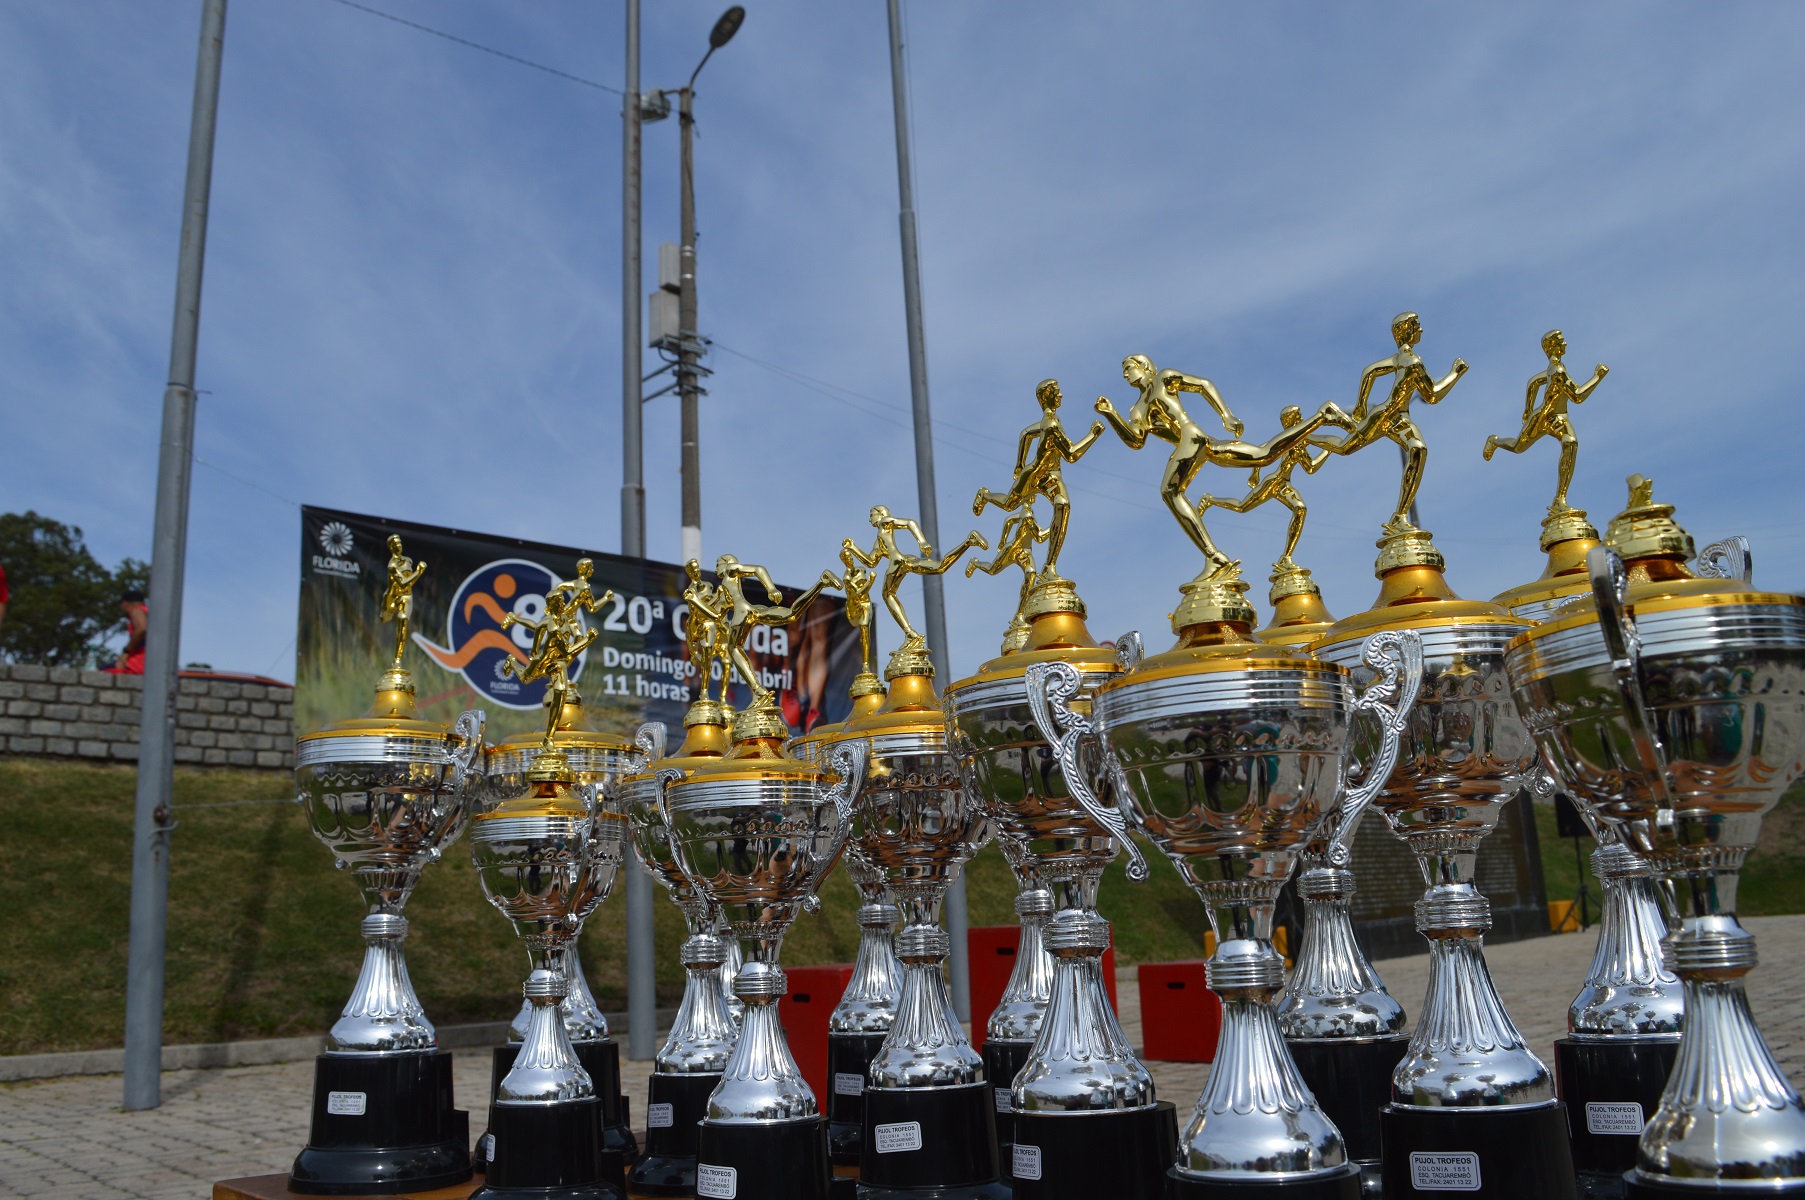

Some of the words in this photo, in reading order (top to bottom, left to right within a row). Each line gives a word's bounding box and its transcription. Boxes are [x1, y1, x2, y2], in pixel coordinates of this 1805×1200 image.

[313, 555, 361, 575] FLORIDA
[603, 646, 696, 681] Domingo
[603, 674, 630, 696] 11
[636, 675, 690, 703] horas
[709, 1169, 731, 1177] TROFEOS
